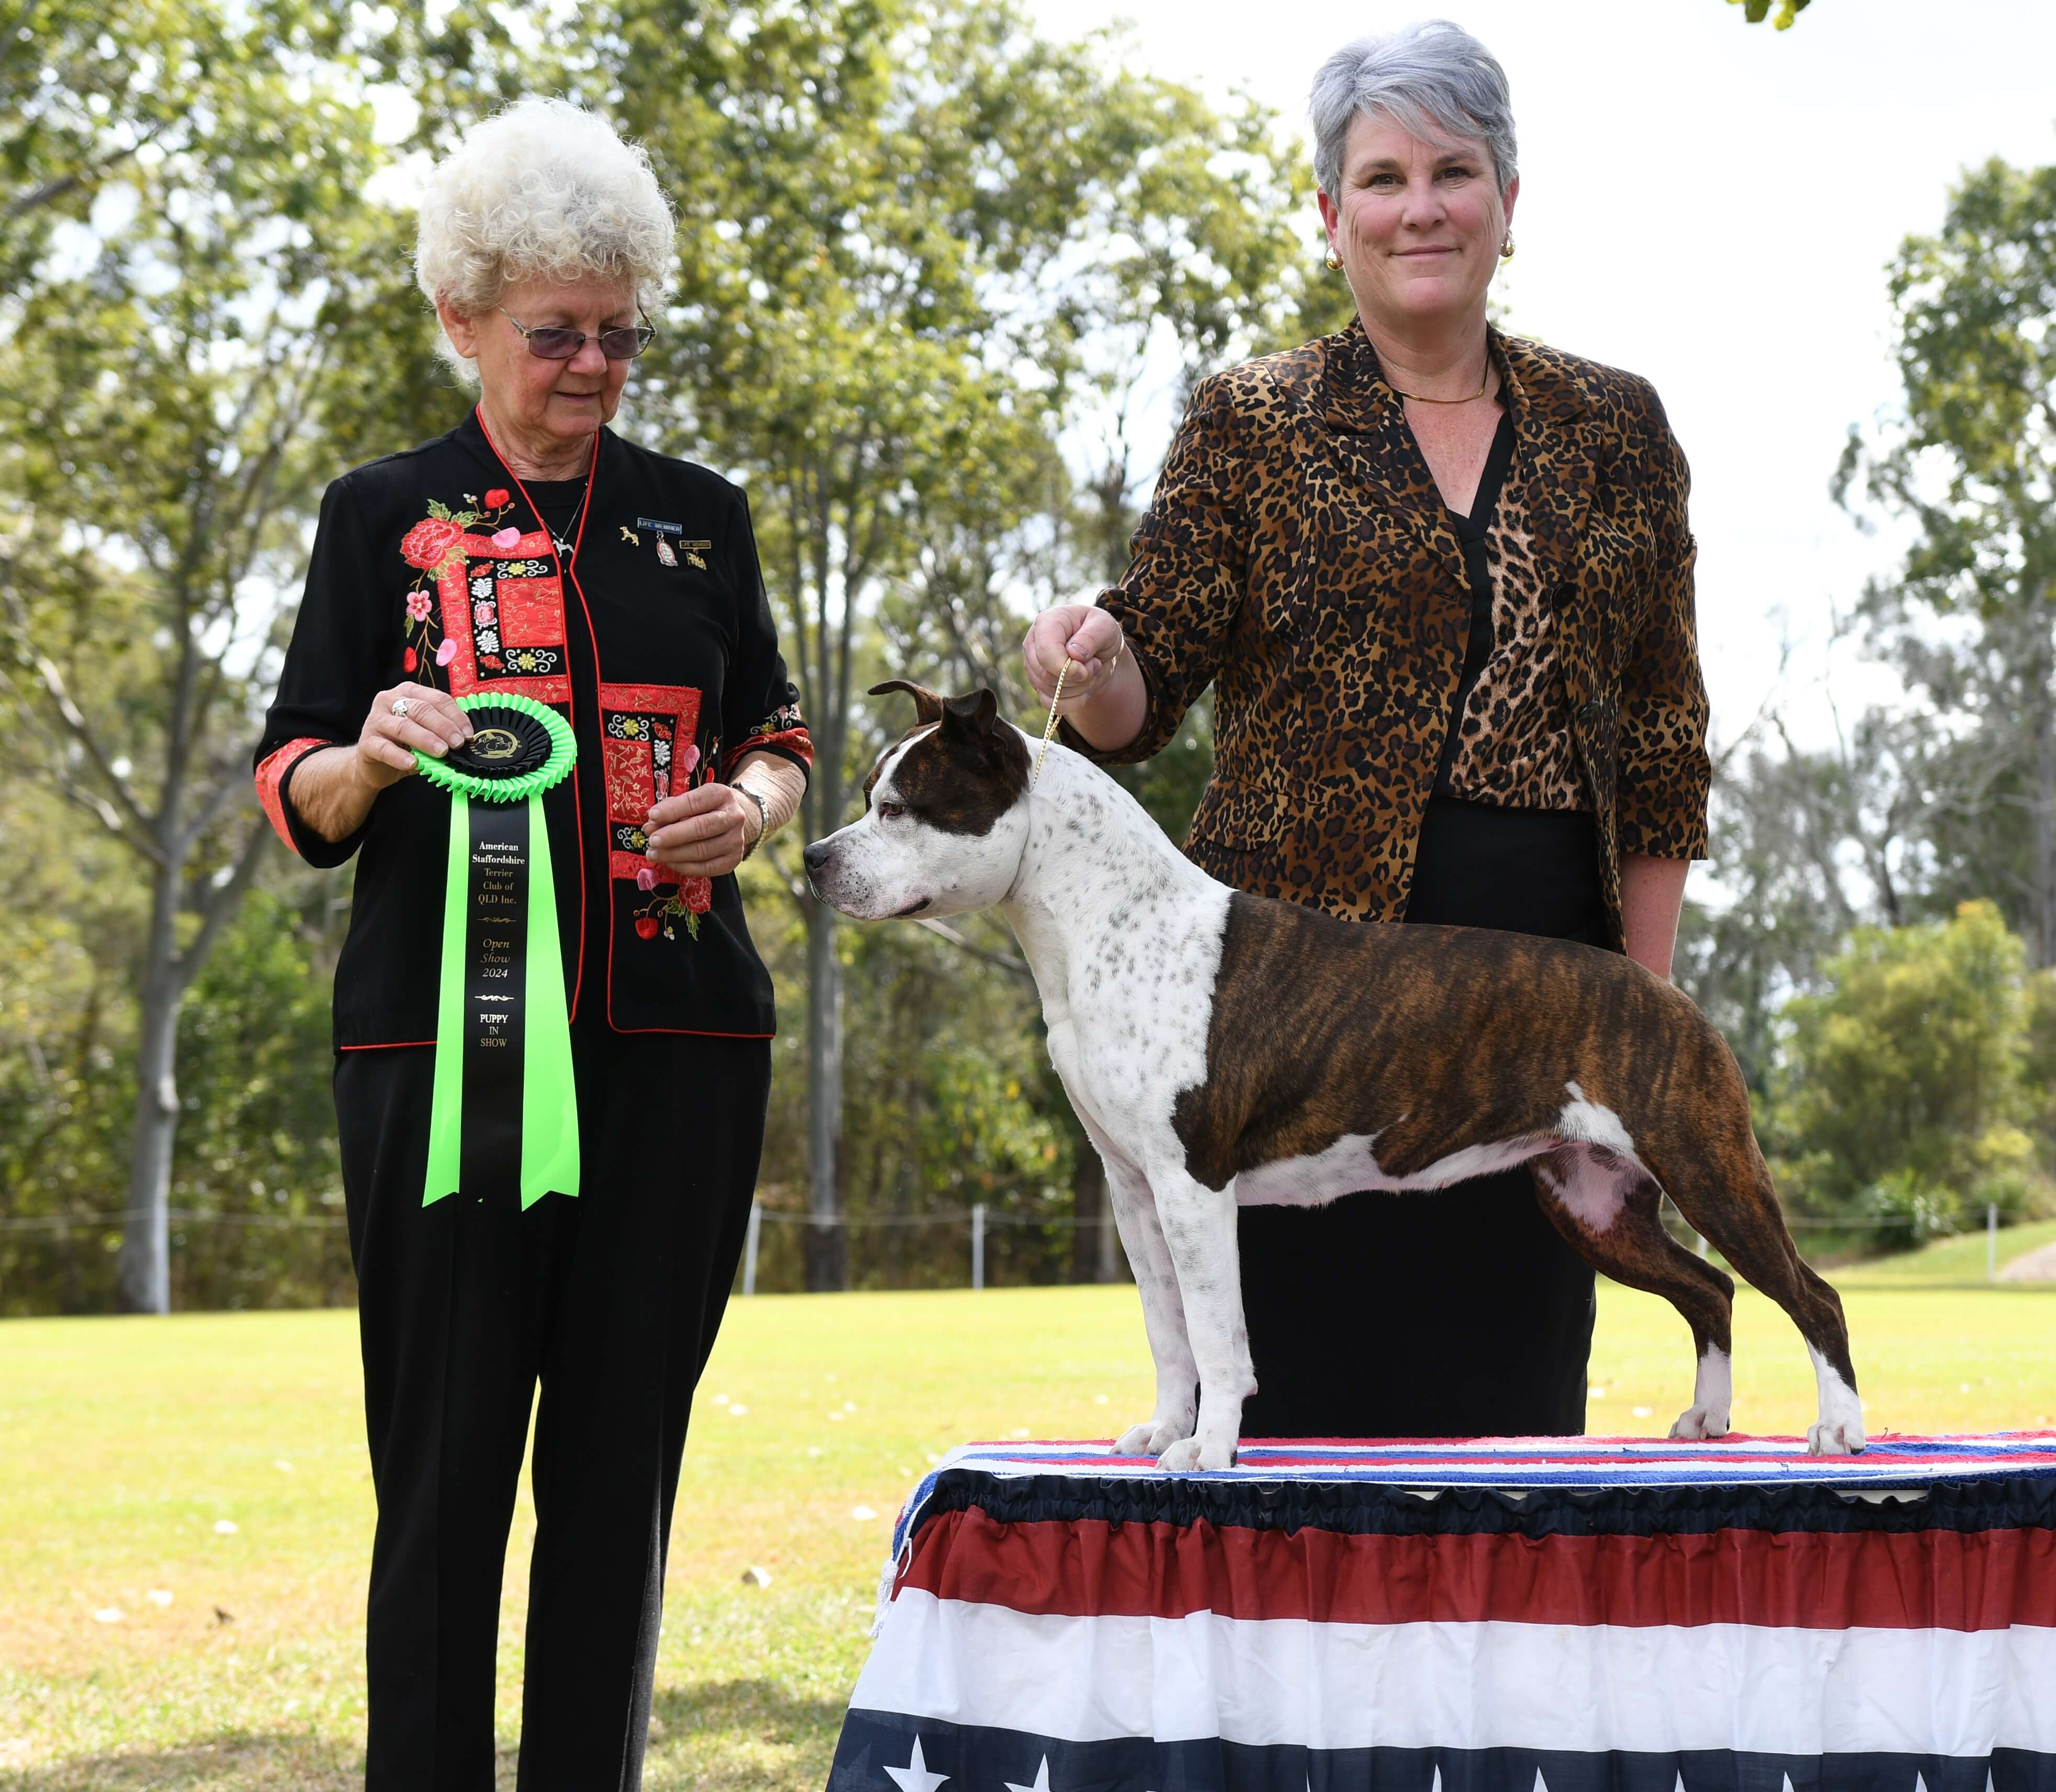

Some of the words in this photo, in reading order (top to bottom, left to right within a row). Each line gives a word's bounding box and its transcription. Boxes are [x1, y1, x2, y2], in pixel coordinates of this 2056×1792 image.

[655, 523, 681, 532] MEMBER
[479, 841, 518, 851] American
[472, 854, 525, 864] Staffordshire
[484, 868, 513, 877] Terrier
[483, 881, 502, 890] Club
[505, 882, 514, 891] of
[478, 894, 498, 905] QLD
[501, 895, 516, 904] Inc.
[483, 938, 510, 951] Open
[481, 952, 511, 963] Show
[482, 968, 508, 978] 2024
[480, 1014, 509, 1023] PUPPY
[489, 1026, 499, 1035] IN
[480, 1038, 507, 1047] SHOW
